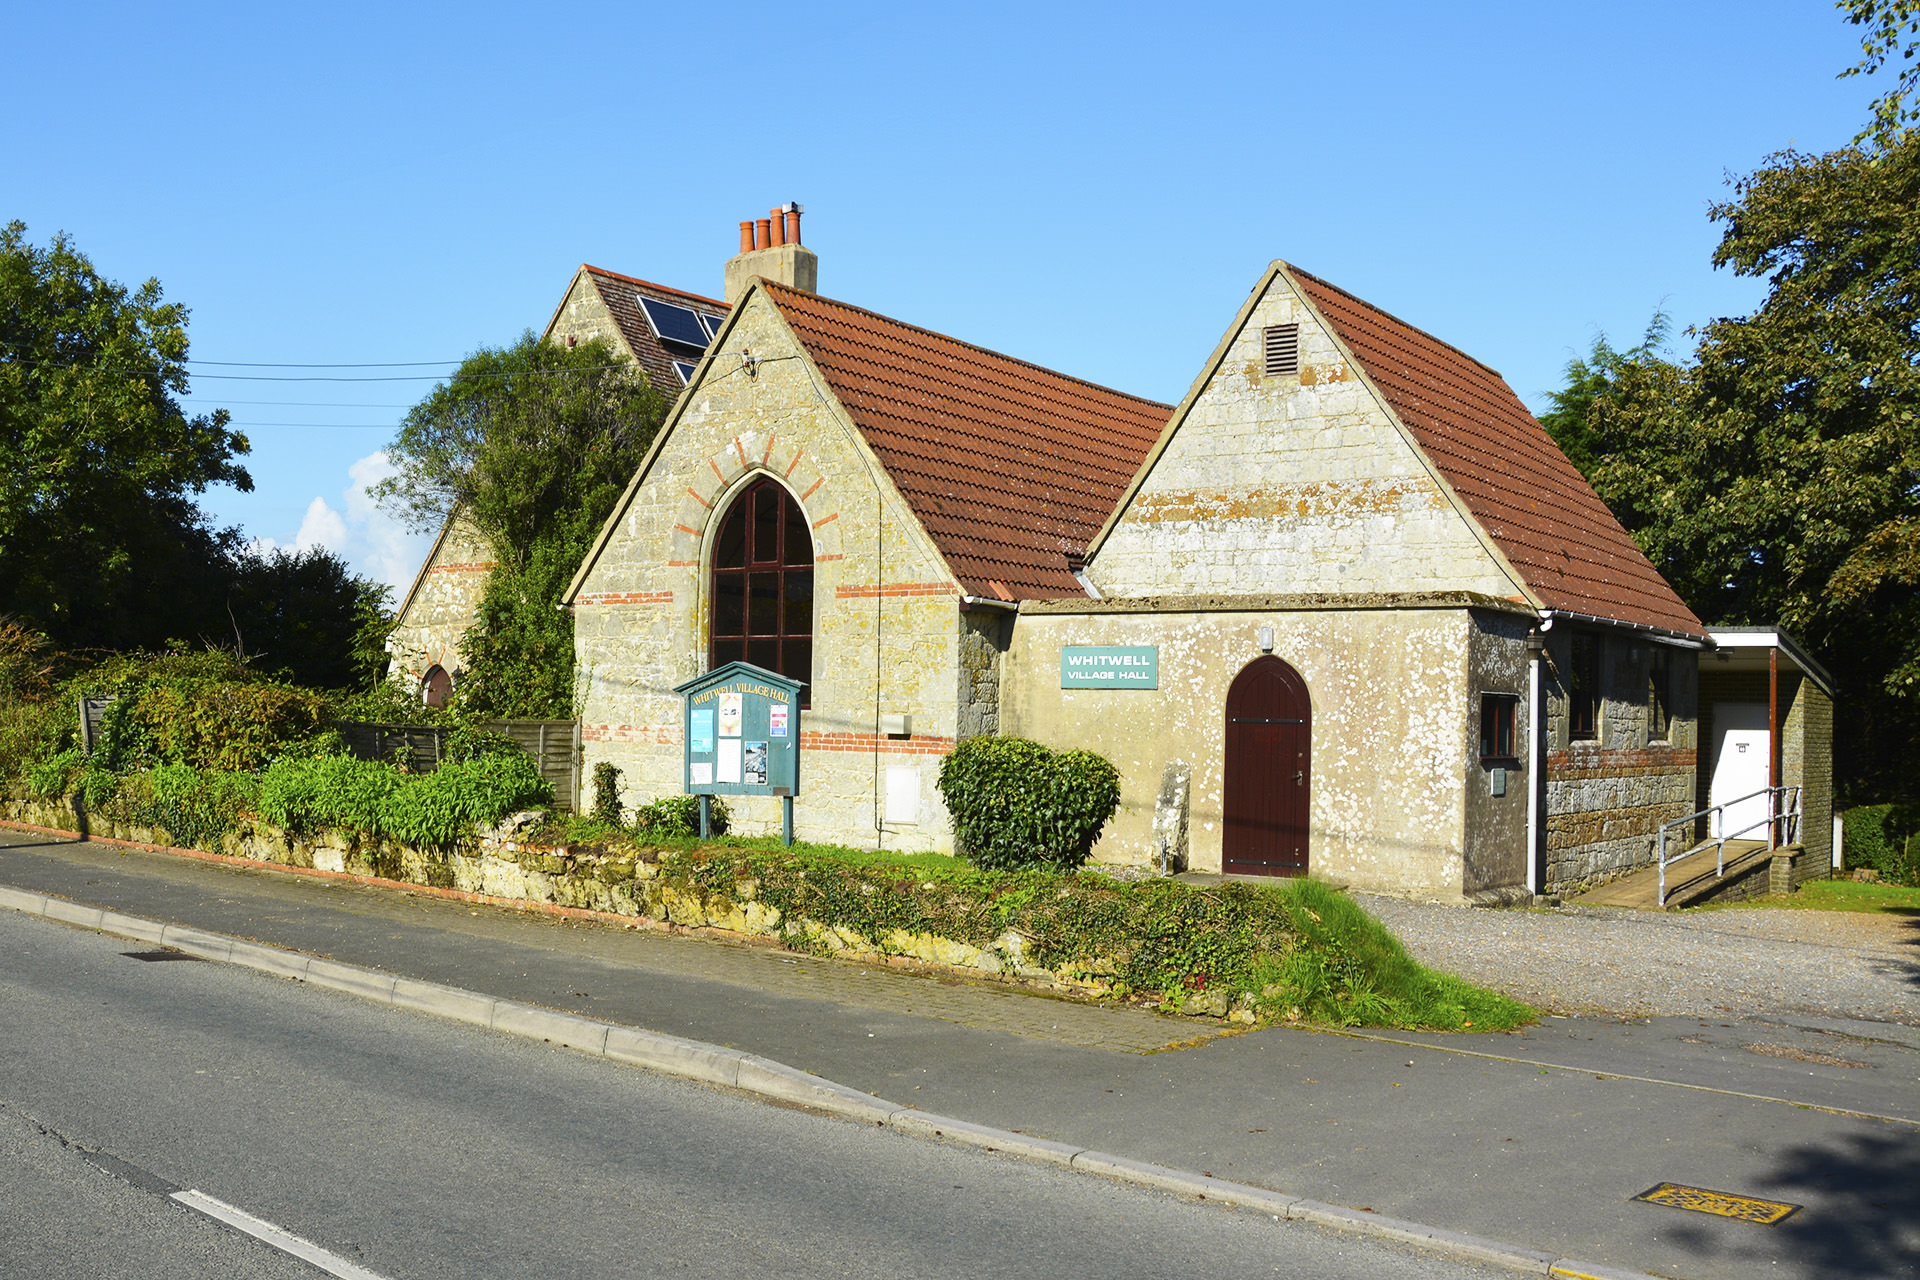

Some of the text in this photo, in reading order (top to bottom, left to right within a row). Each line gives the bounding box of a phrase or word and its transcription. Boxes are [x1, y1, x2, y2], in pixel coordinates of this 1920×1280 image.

[1068, 656, 1150, 665] WHITWELL
[693, 683, 790, 705] WHITWELL VILLAGE HALL
